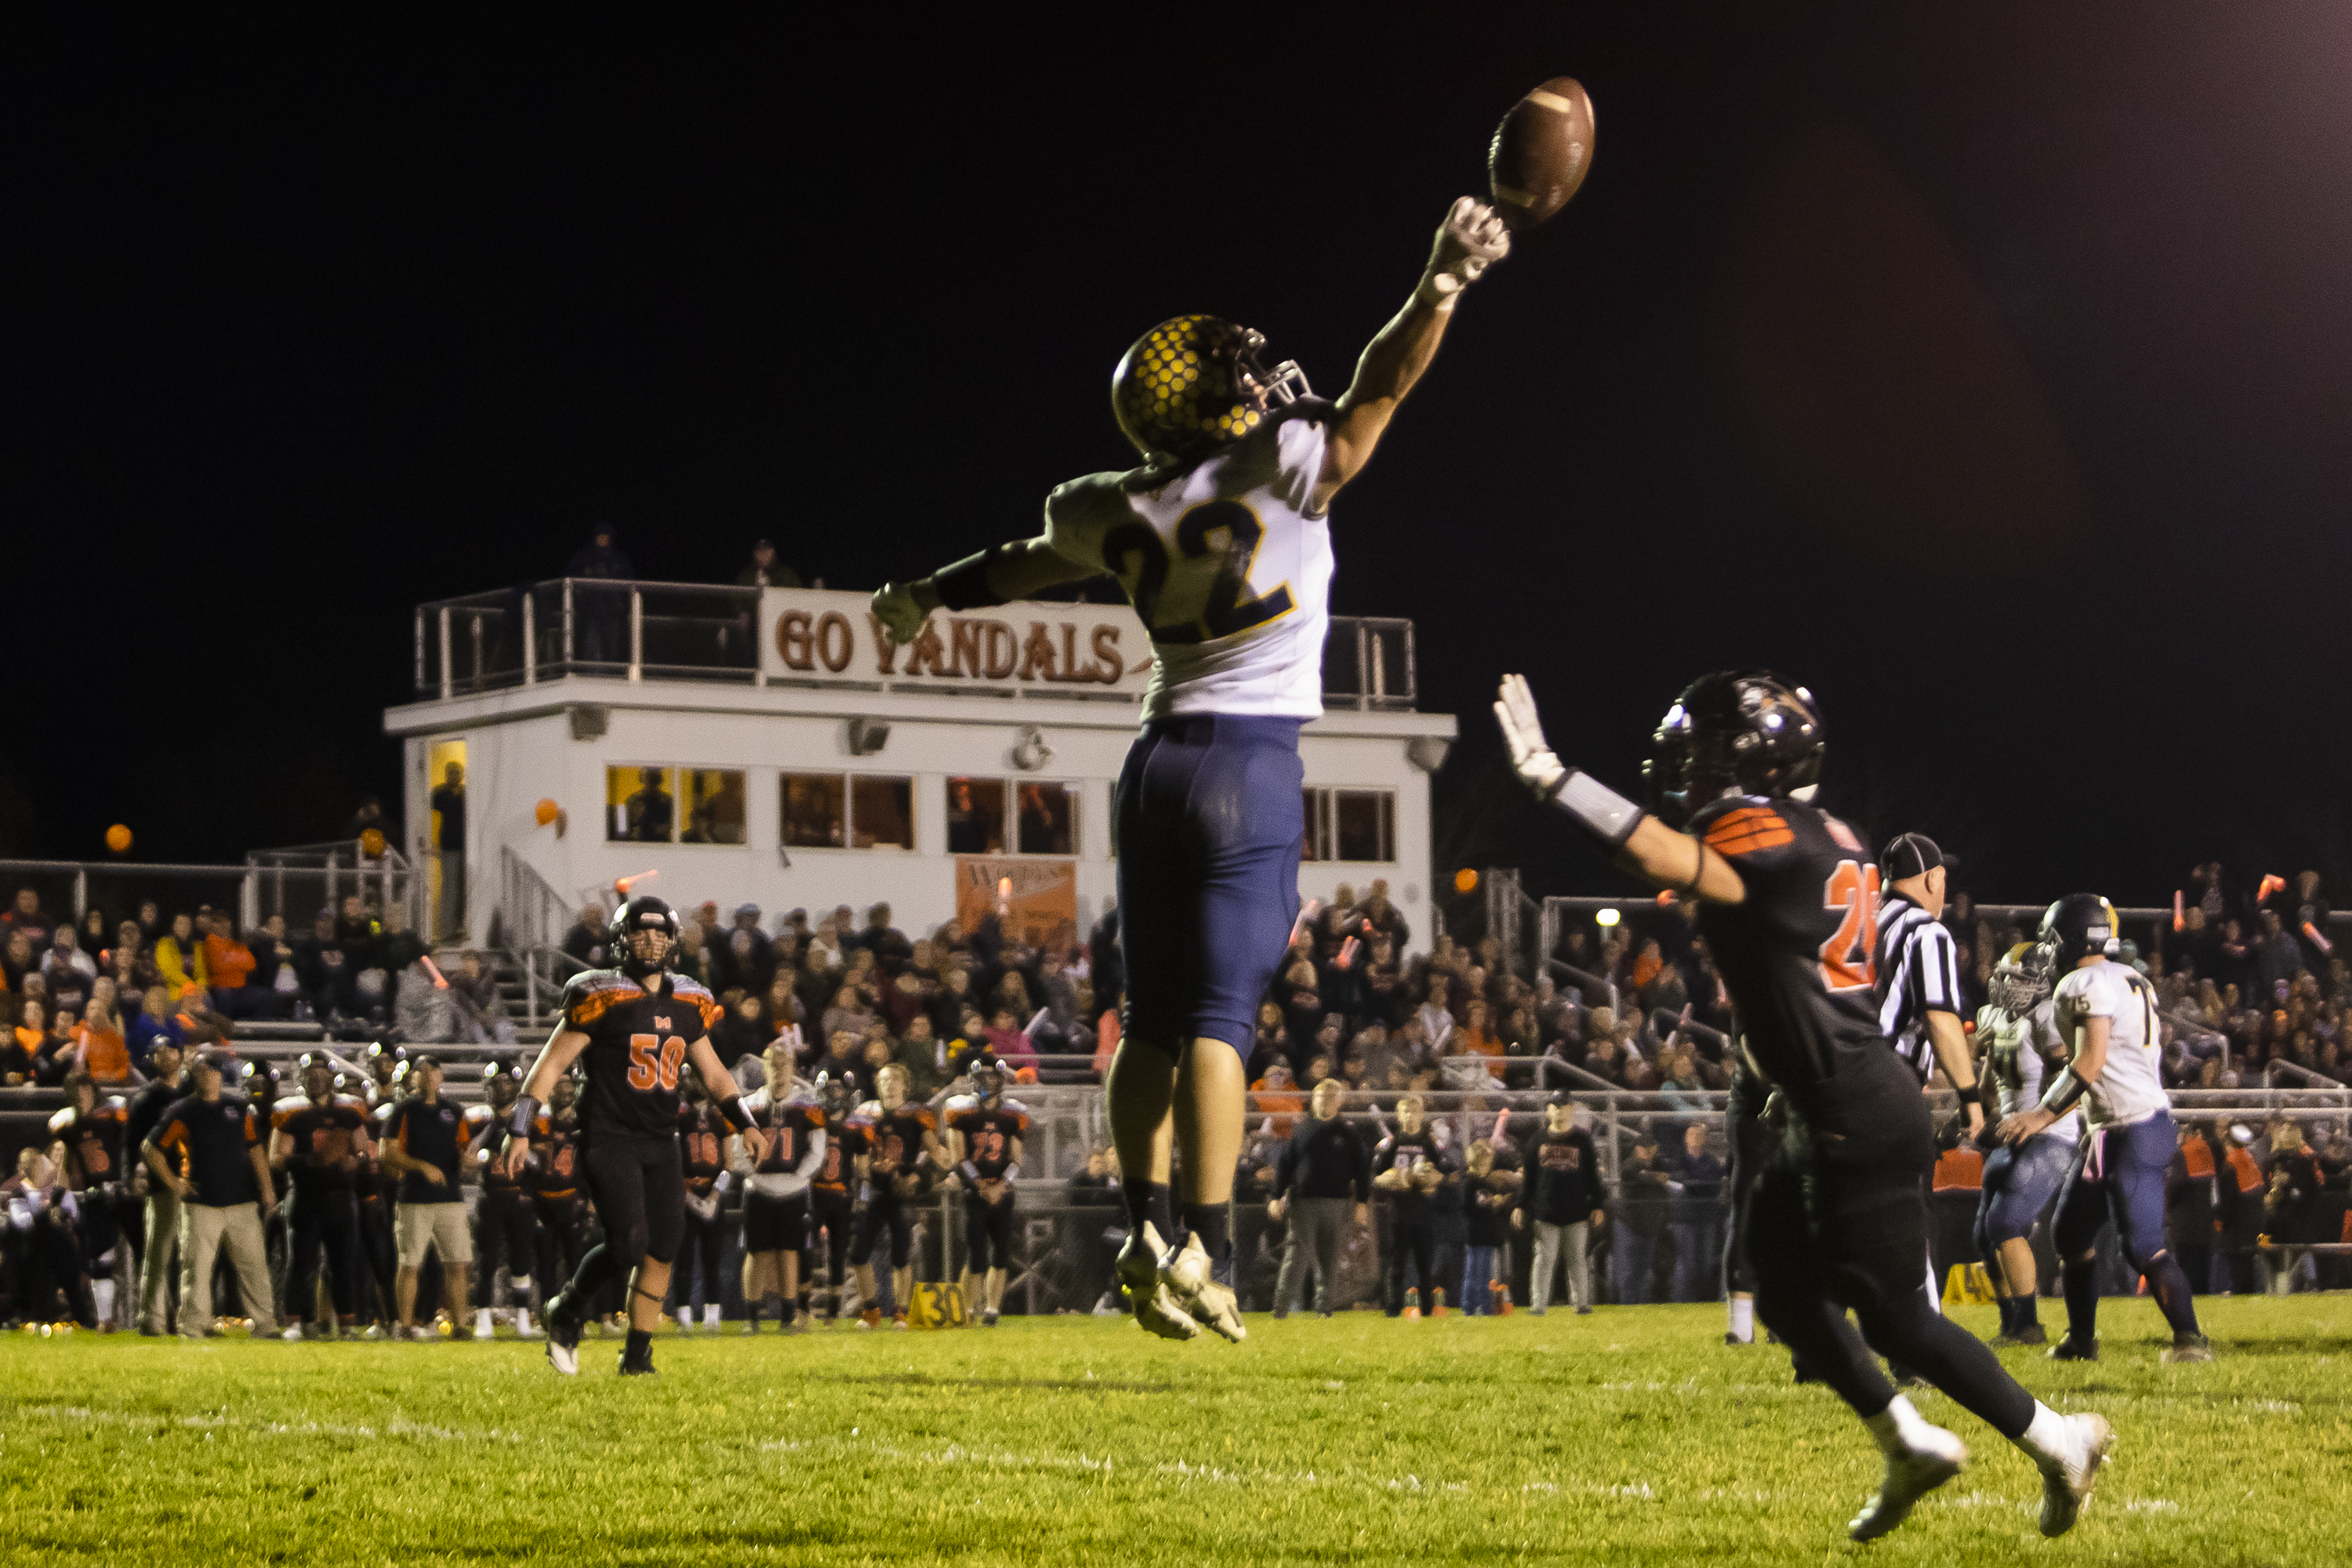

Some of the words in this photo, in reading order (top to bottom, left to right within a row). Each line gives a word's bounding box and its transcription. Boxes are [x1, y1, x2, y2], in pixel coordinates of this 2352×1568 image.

[1102, 496, 1298, 644] 22
[775, 608, 854, 673] GO
[2124, 975, 2159, 1048] 7
[627, 1033, 686, 1091] 50
[922, 1283, 967, 1327] 30
